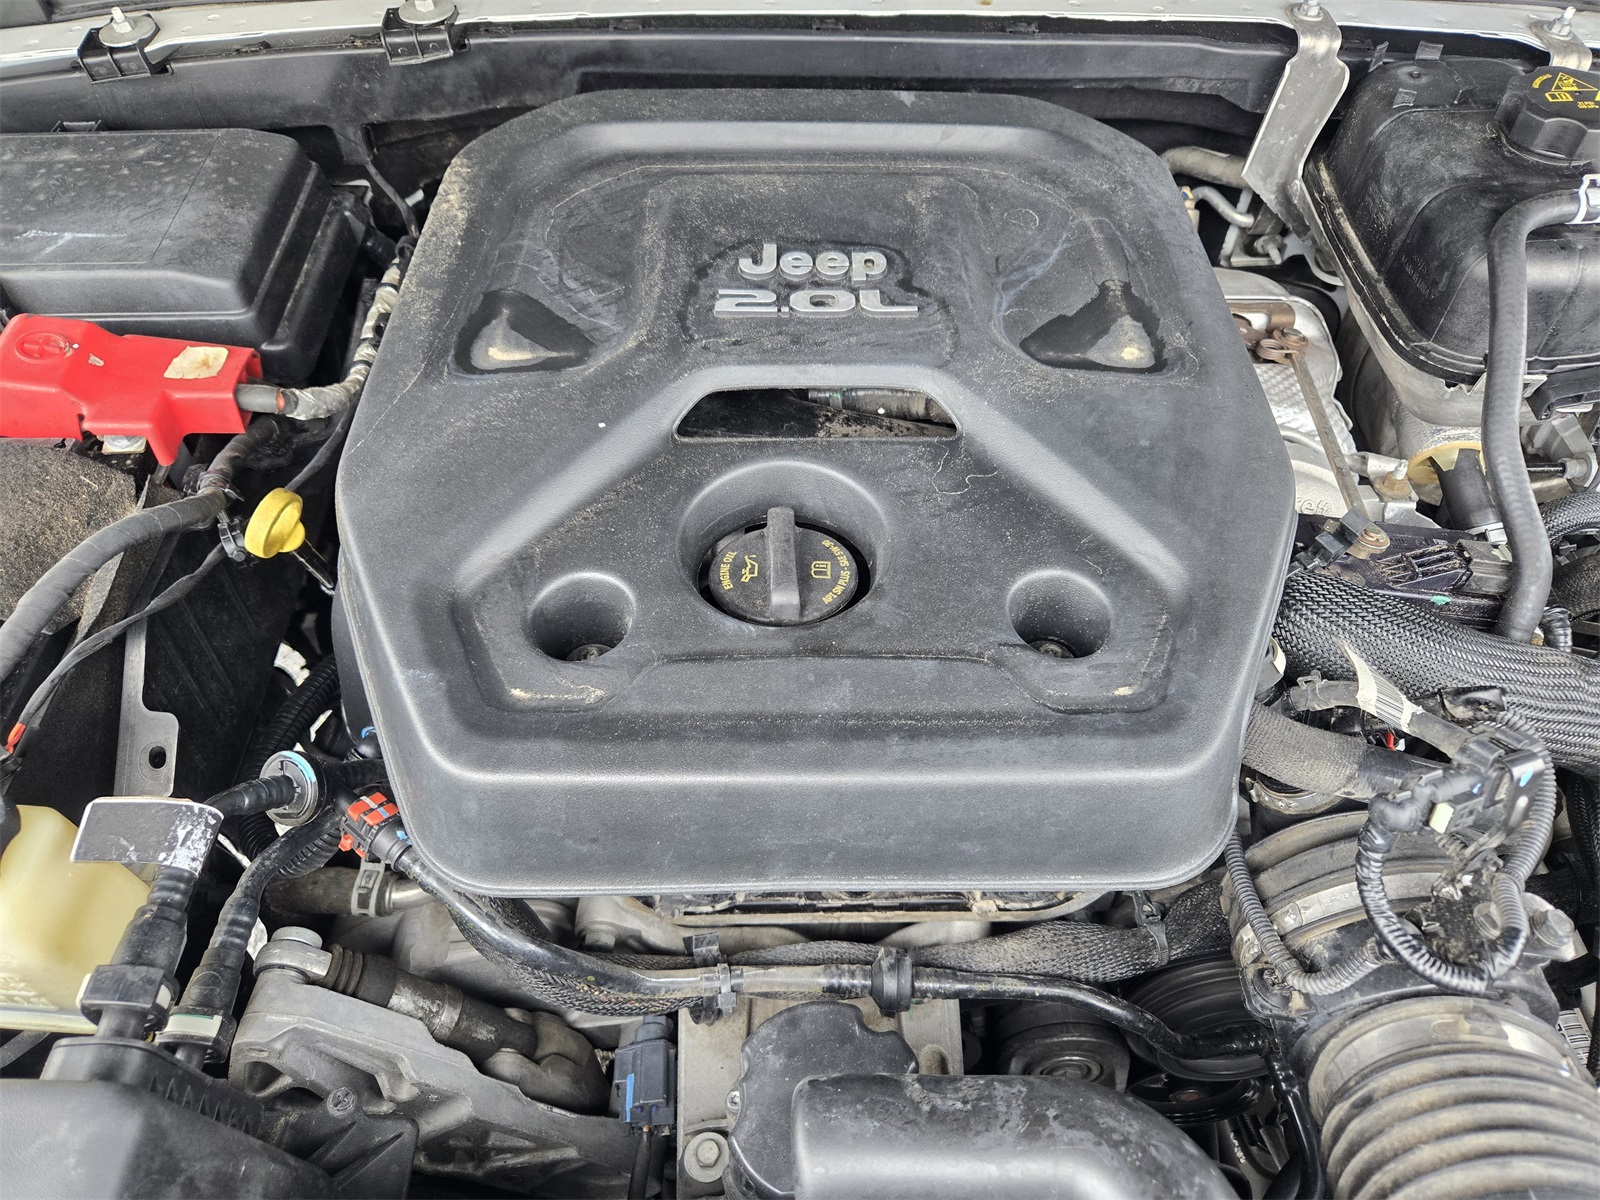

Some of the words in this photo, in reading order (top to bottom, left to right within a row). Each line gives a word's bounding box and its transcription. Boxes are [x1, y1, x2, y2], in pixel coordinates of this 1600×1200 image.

[738, 243, 887, 286] Jeep
[714, 289, 919, 317] 2.0L
[722, 551, 738, 563] OIL
[837, 555, 850, 567] SAE
[719, 563, 734, 590] ENGINE
[837, 570, 851, 586] PLUS
[821, 591, 838, 605] API
